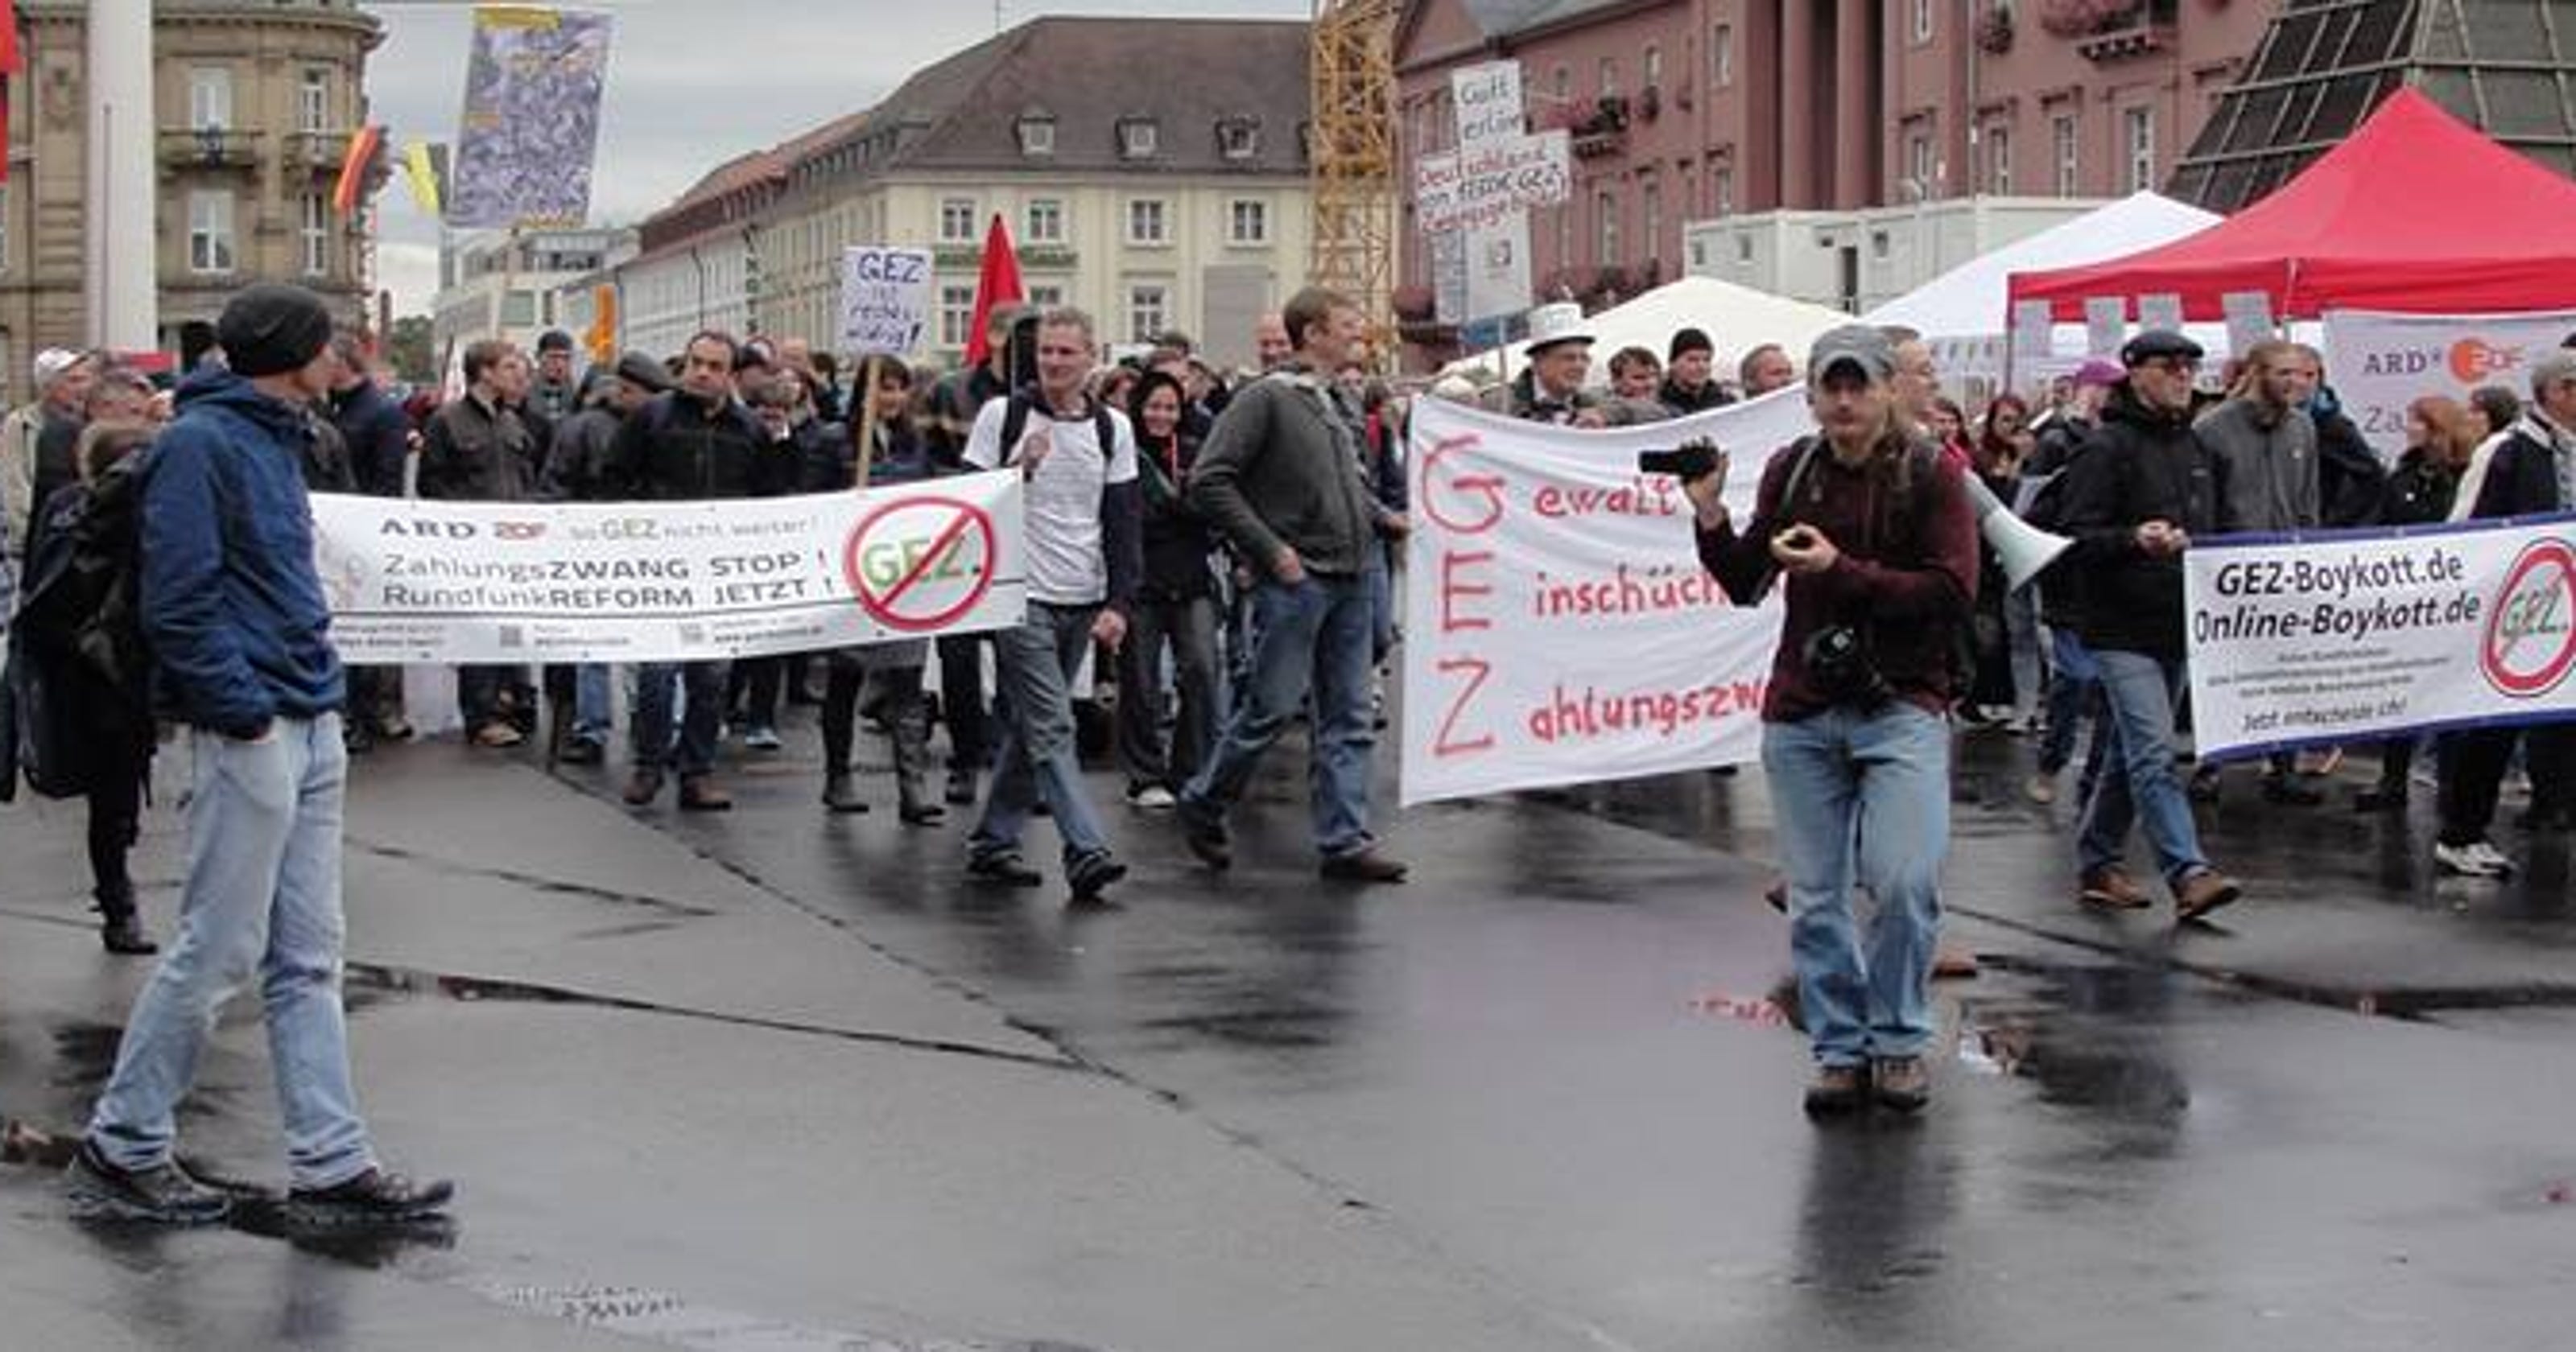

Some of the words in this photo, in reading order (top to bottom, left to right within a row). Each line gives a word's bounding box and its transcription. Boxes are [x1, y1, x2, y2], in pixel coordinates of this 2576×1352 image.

[857, 251, 924, 283] GEZ
[381, 517, 477, 539] ARD
[383, 553, 690, 584] ZahlungsZWANG
[709, 550, 801, 577] STOP
[2215, 548, 2464, 599] GEZ-Boykott.de
[382, 583, 694, 609] RundfunkREFORM
[714, 579, 806, 605] JETZT
[2194, 591, 2482, 644] Online-Boykott.de
